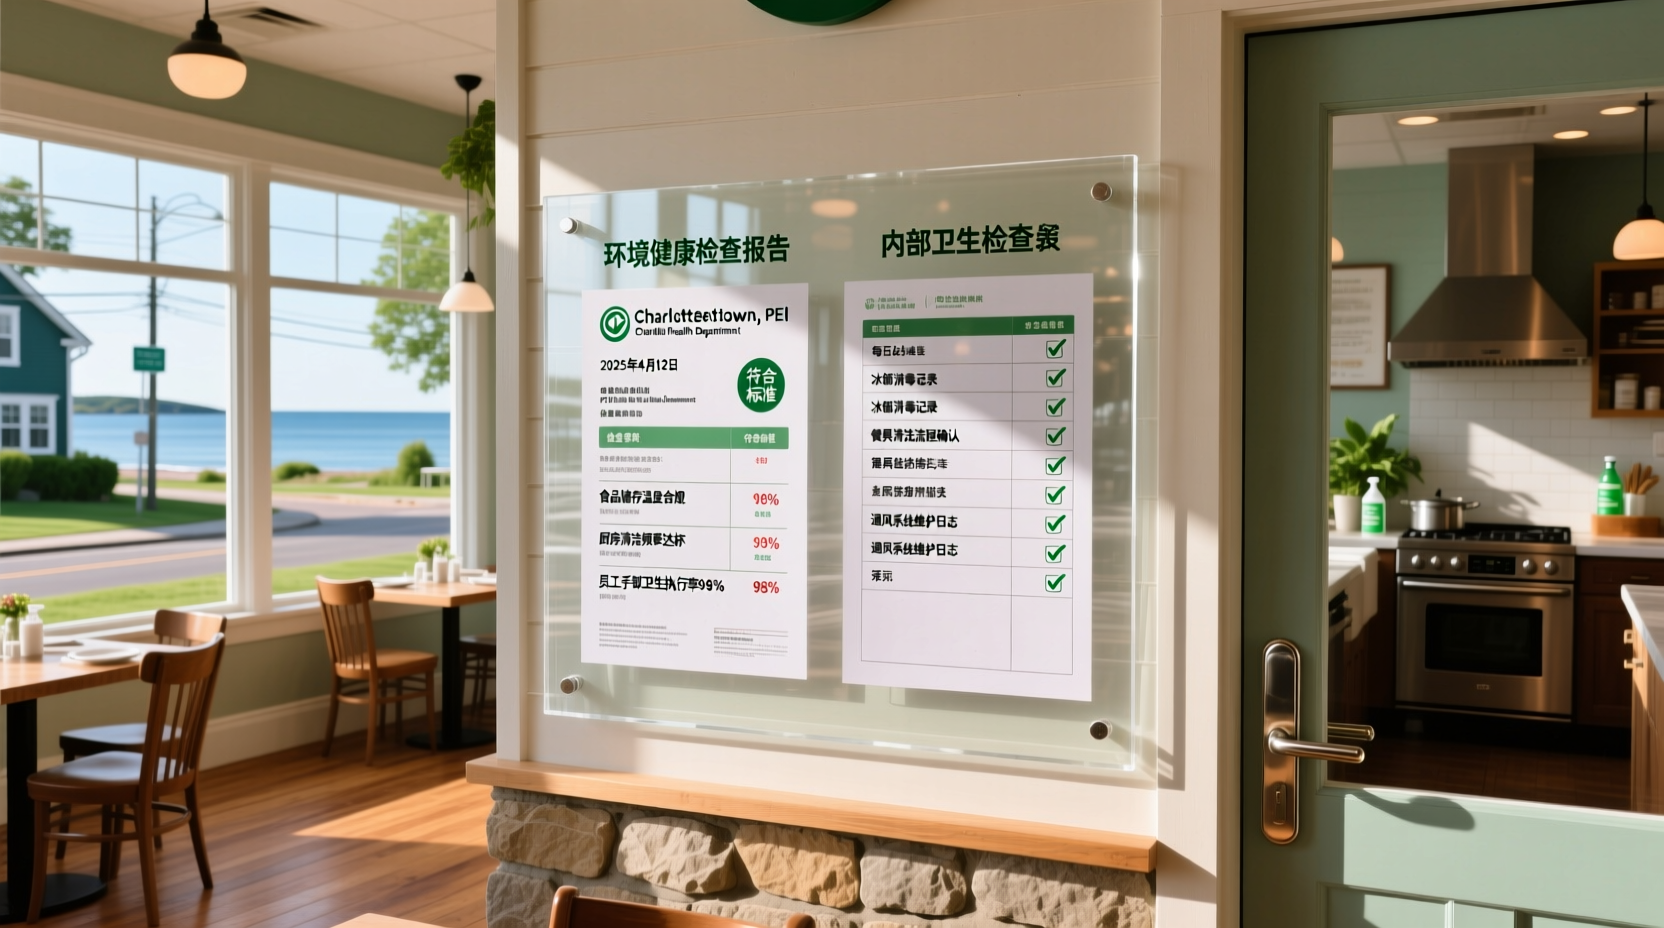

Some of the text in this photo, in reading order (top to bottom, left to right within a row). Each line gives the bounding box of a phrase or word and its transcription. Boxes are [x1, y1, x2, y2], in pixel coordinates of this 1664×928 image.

[604, 234, 790, 268] 环境健康检查报告
[766, 307, 788, 321] PEI
[601, 358, 677, 372] 2025年4月12日
[754, 581, 779, 593] 98%
